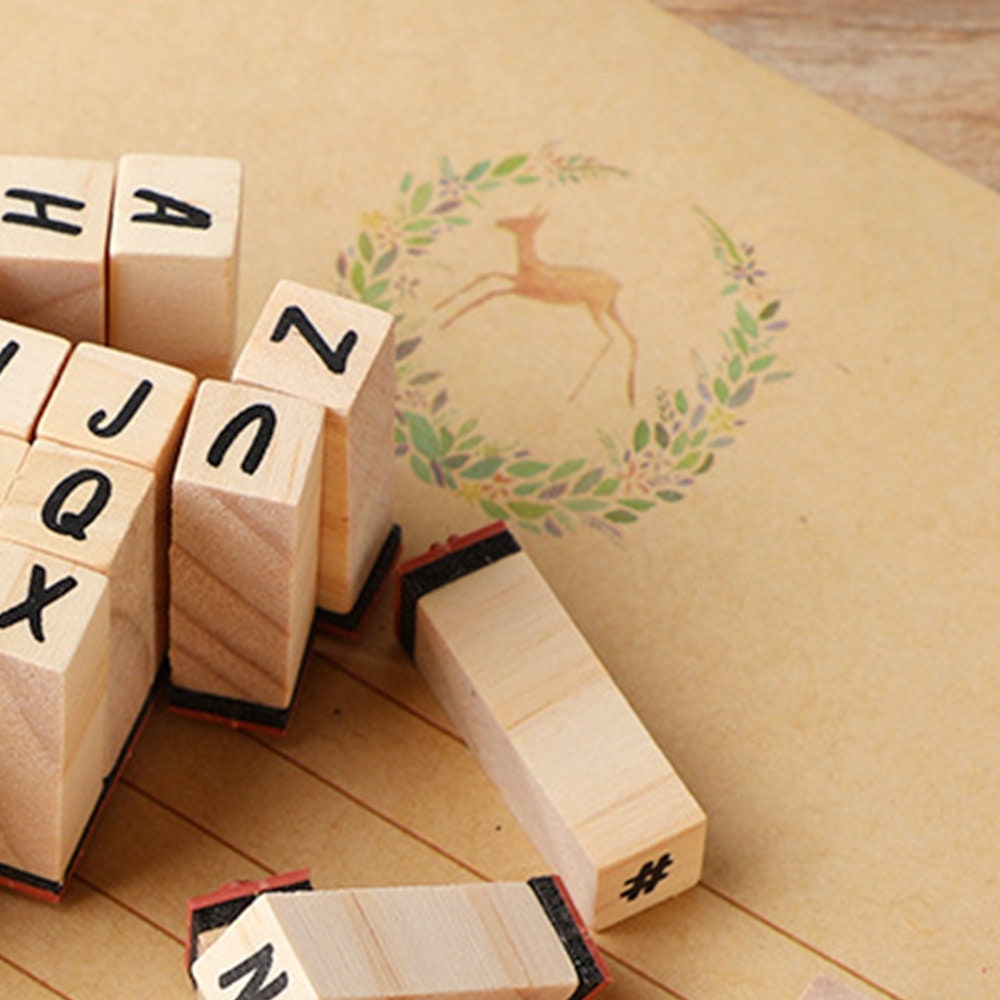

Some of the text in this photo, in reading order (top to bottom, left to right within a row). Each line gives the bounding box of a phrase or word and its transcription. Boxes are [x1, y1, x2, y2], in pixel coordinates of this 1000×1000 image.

[2, 189, 85, 236] H
[131, 189, 212, 230] A
[87, 380, 153, 438] J
[41, 469, 112, 541] Q
[619, 853, 674, 902] #
